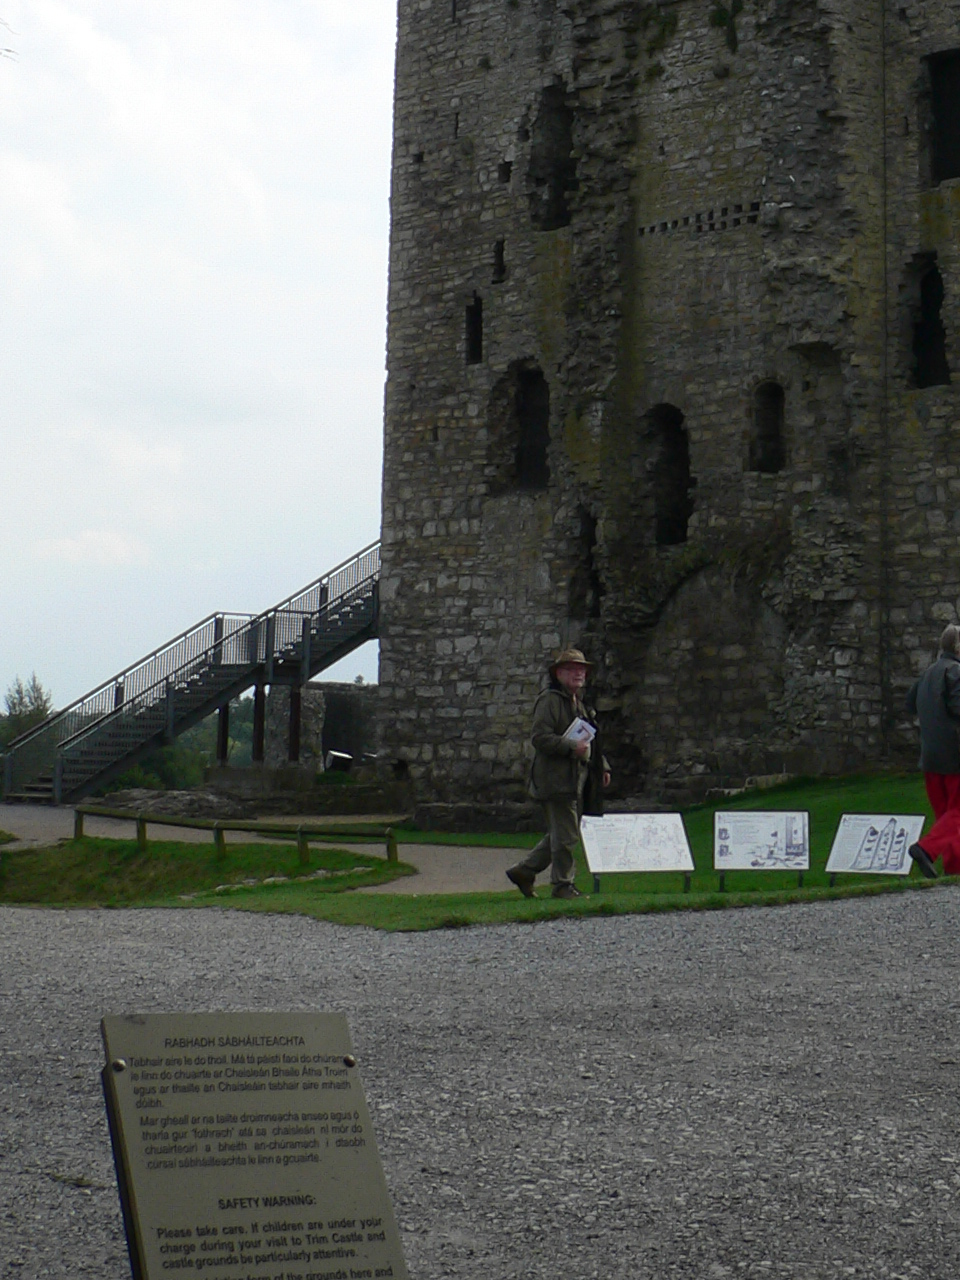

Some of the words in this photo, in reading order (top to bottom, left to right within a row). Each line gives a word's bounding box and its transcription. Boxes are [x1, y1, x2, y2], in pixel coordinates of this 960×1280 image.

[165, 1036, 215, 1048] RABHADH
[194, 1055, 206, 1065] do
[301, 1053, 311, 1063] do
[161, 1070, 172, 1080] do
[324, 1066, 348, 1076] Troim
[133, 1086, 156, 1097] agus
[330, 1112, 352, 1123] agus
[351, 1124, 363, 1133] do
[218, 1197, 260, 1210] SAFETY
[262, 1194, 317, 1207] WARNING:
[157, 1227, 192, 1238] Please
[196, 1225, 218, 1236] take
[222, 1224, 248, 1235] care.
[251, 1222, 258, 1233] If
[262, 1221, 304, 1233] children
[307, 1221, 324, 1230] are
[328, 1218, 356, 1229] under
[360, 1218, 382, 1230] your
[160, 1243, 196, 1255] charge
[200, 1240, 234, 1252] during
[238, 1240, 262, 1251] your
[266, 1236, 287, 1247] visit
[291, 1235, 302, 1246] to
[305, 1233, 328, 1245] Trim
[332, 1231, 363, 1243] Castle
[367, 1230, 386, 1240] and
[162, 1257, 194, 1269] castle
[195, 1254, 239, 1270] grounds
[240, 1253, 253, 1264] be
[255, 1249, 311, 1265] particularly
[313, 1248, 359, 1259] attentive.
[349, 1267, 373, 1278] here
[375, 1265, 393, 1277] and
